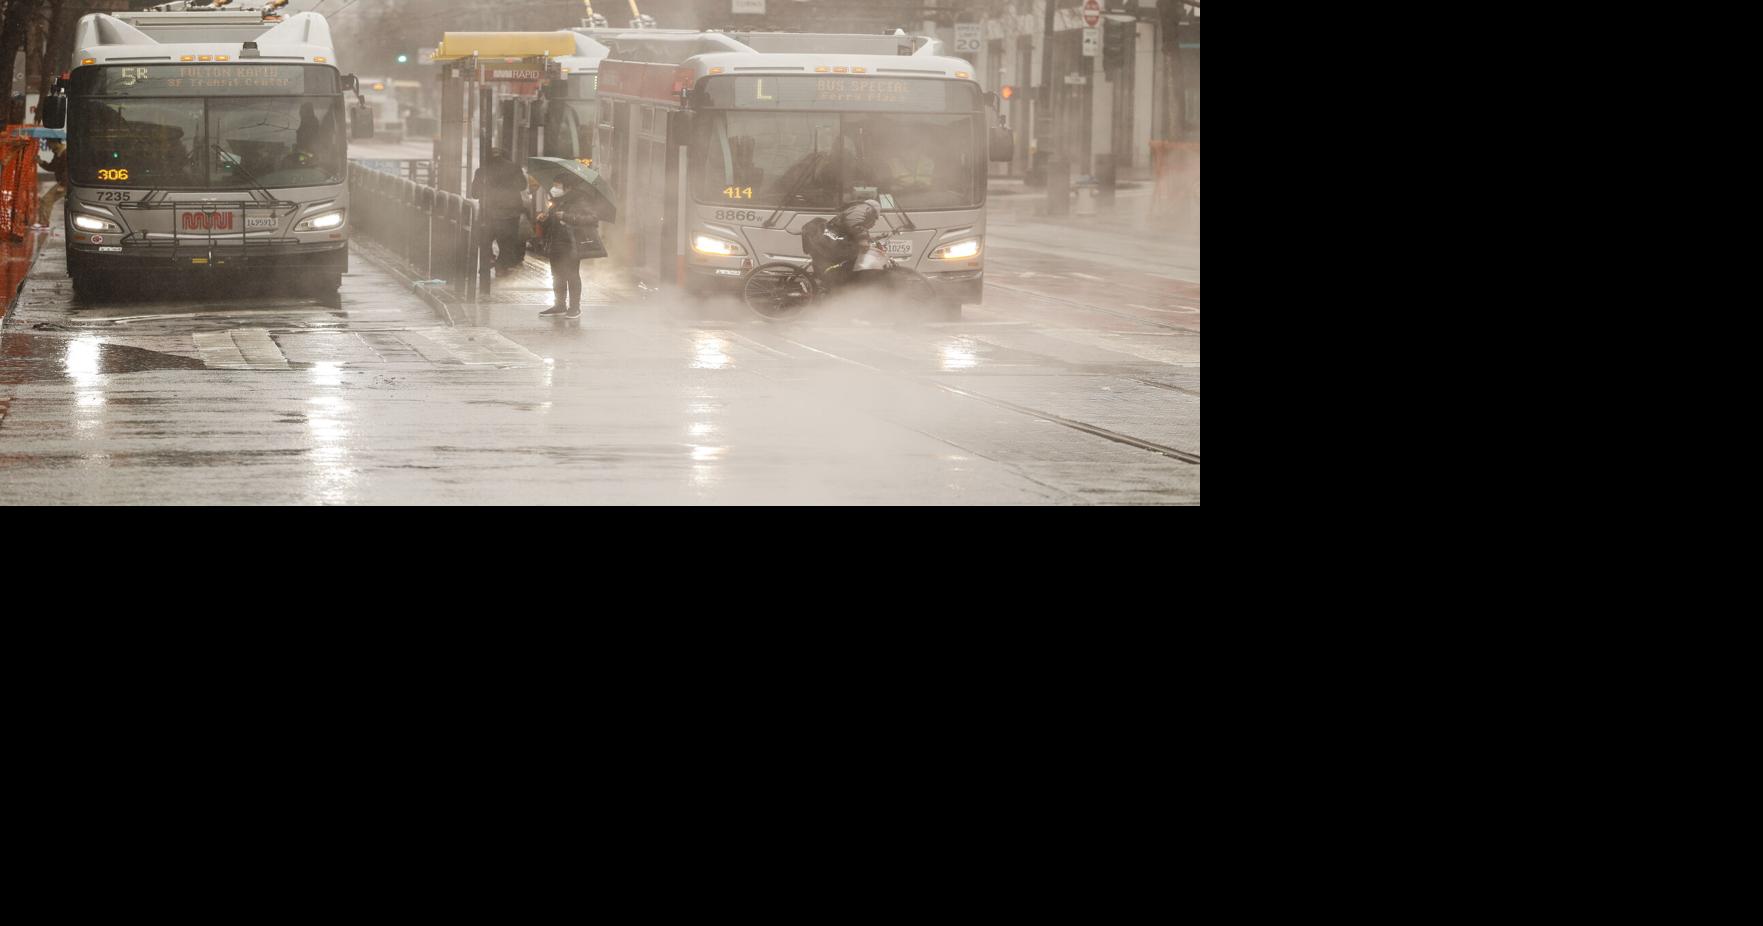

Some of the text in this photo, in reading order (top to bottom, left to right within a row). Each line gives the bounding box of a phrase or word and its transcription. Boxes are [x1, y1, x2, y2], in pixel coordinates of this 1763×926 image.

[957, 39, 980, 50] 20
[121, 67, 148, 86] 5R
[180, 66, 278, 77] FULTON RAPID
[512, 70, 540, 79] RAPID
[757, 79, 772, 99] L
[817, 79, 844, 91] BUS
[98, 169, 129, 180] 306
[96, 191, 131, 201] 7235
[723, 186, 753, 199] 414
